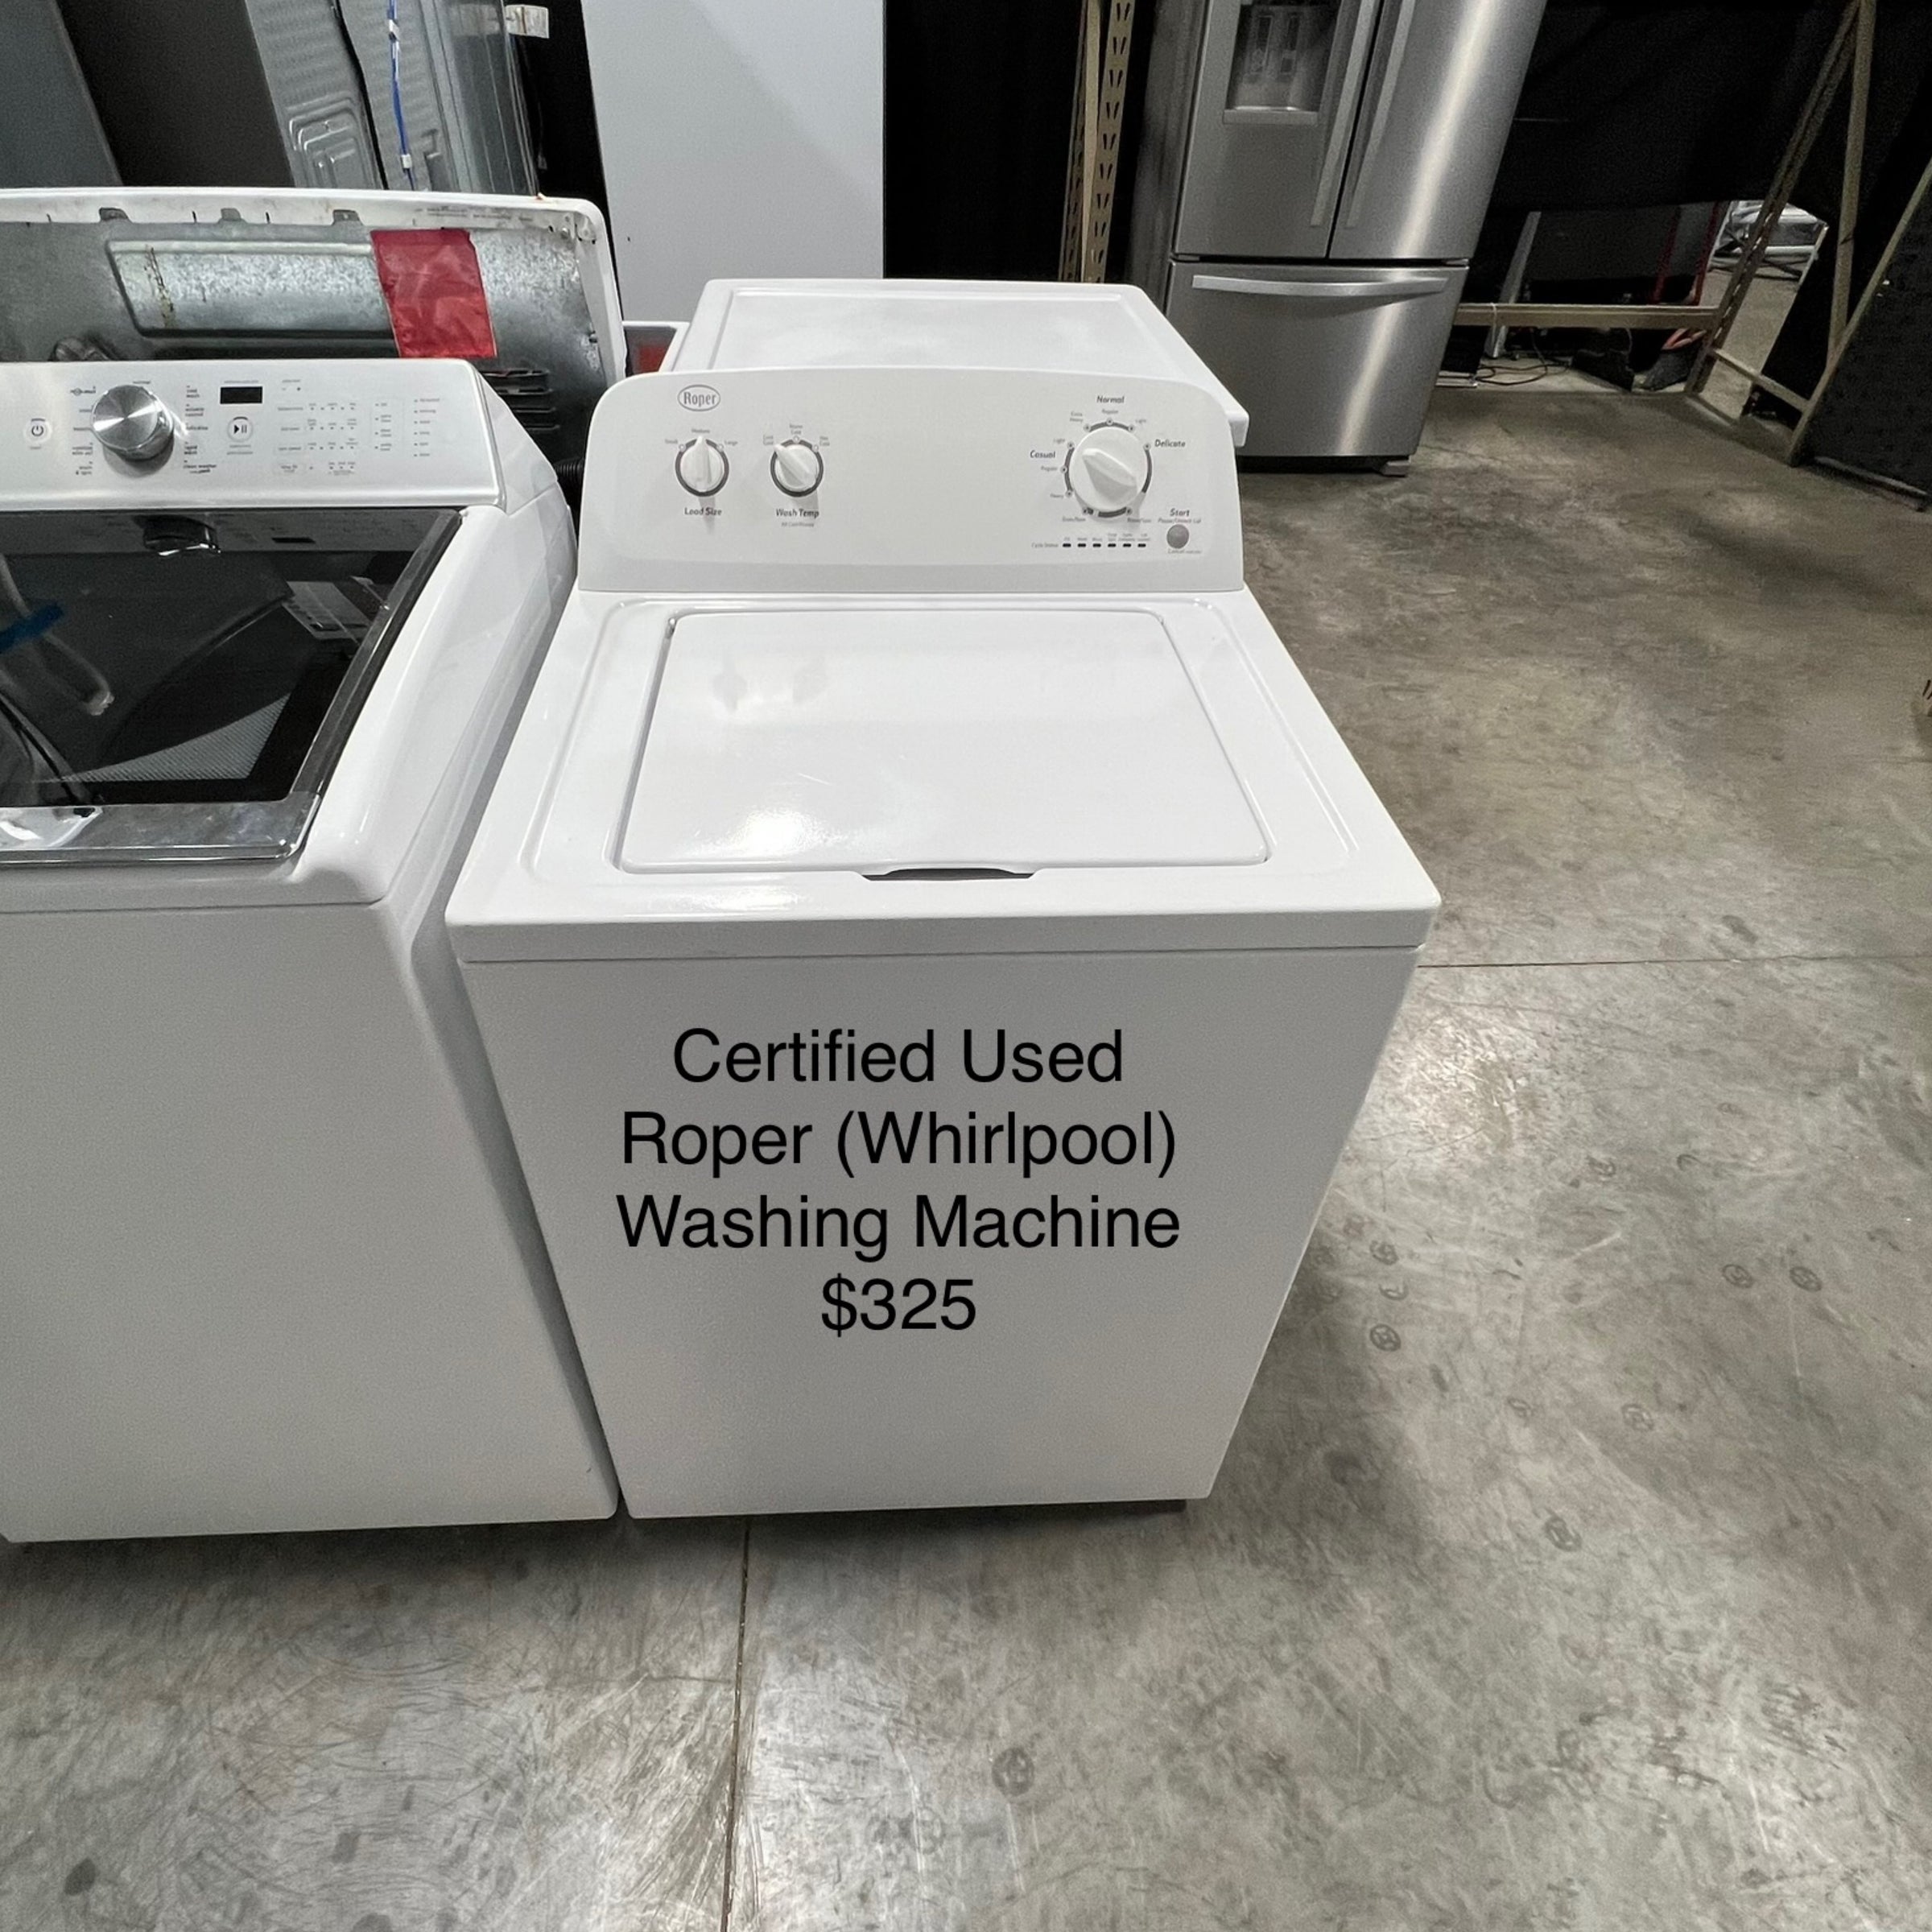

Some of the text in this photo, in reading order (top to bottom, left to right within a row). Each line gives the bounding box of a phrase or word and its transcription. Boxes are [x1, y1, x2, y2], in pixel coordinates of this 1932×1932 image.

[684, 391, 717, 407] Roper
[1096, 395, 1125, 403] Normal
[1154, 438, 1186, 448] Delicate
[1030, 449, 1056, 459] Casual
[684, 506, 723, 516] Load Size
[775, 508, 819, 519] Wash Temp
[1169, 507, 1191, 518] Start
